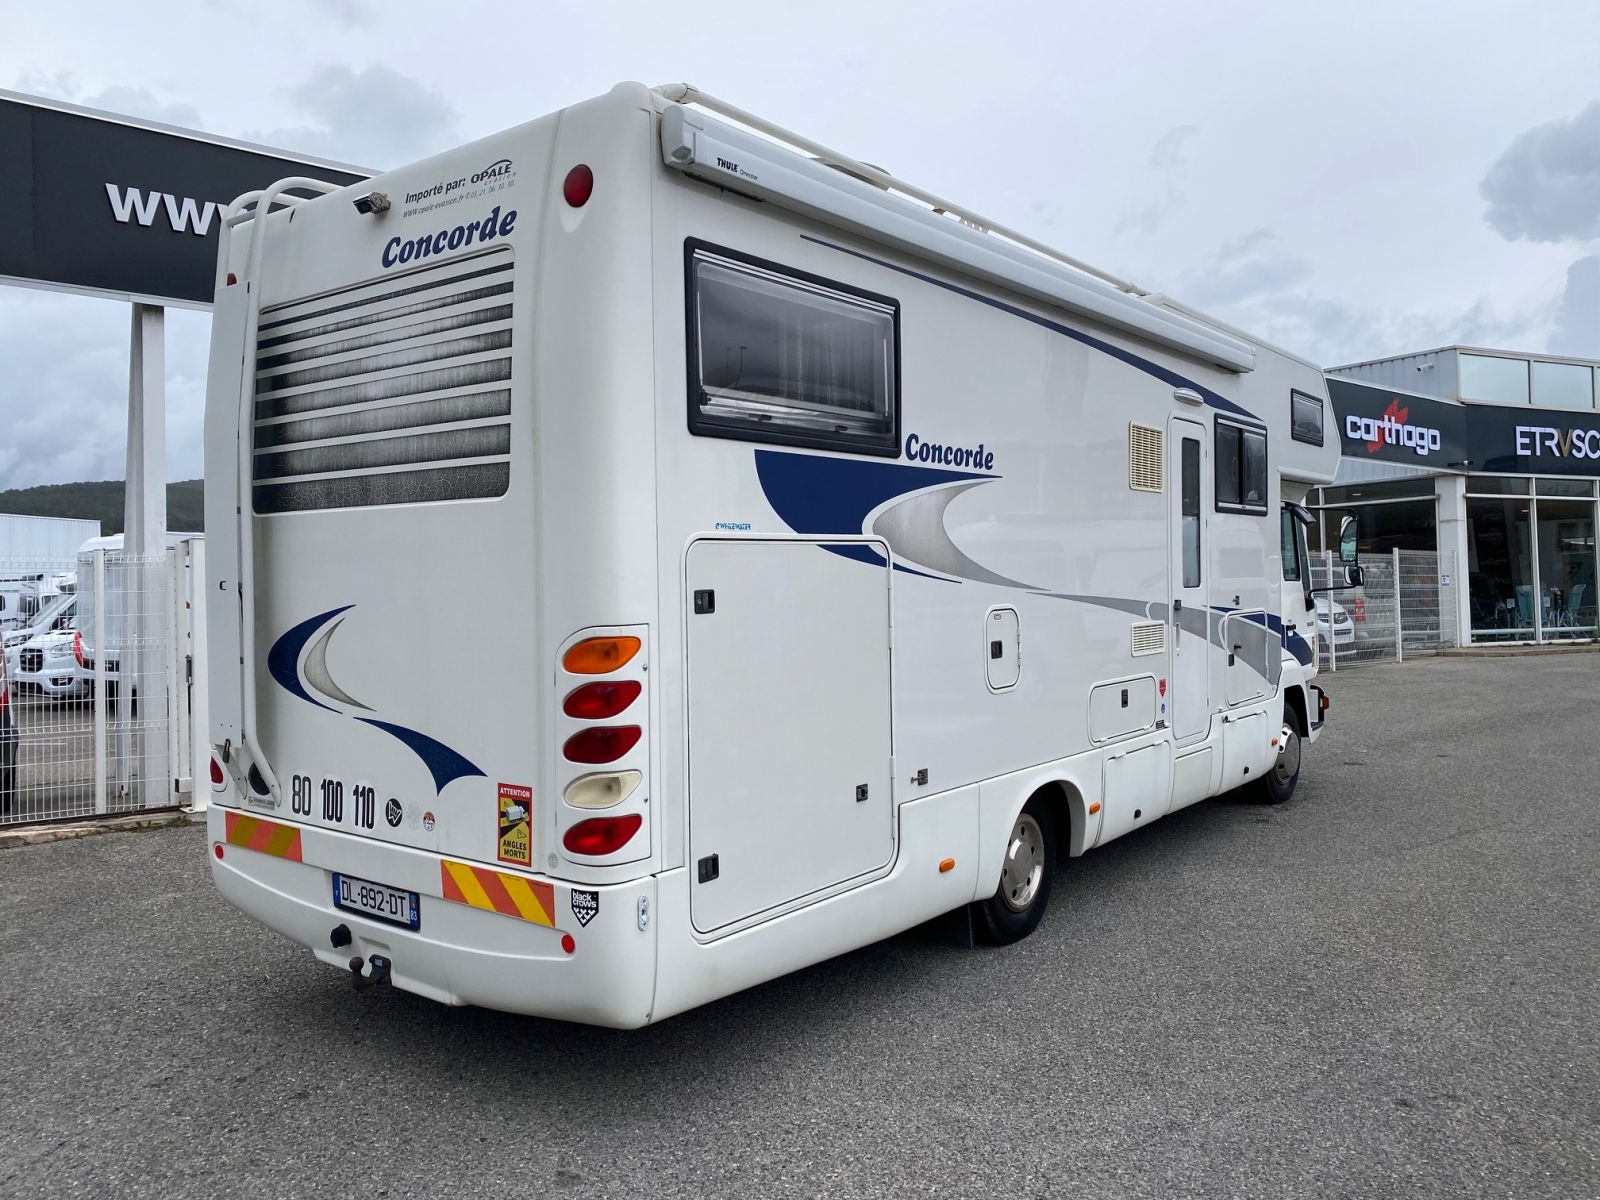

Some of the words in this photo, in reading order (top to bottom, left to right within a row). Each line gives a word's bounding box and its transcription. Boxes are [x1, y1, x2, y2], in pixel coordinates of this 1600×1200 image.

[716, 157, 738, 173] THULE
[405, 182, 443, 204] Importé
[445, 178, 466, 195] par:
[470, 163, 511, 184] OPALE
[382, 205, 517, 268] Concorde
[905, 433, 994, 470] Concorde
[1346, 414, 1441, 456] carthago
[1515, 425, 1600, 459] ETRVSC
[292, 774, 312, 816] 80
[320, 779, 343, 823] 100
[353, 785, 375, 829] 110
[500, 787, 530, 798] ATTENTION
[502, 839, 527, 851] ANGLES
[503, 848, 526, 860] MORTS
[341, 880, 406, 917] DL-892-DT
[572, 890, 592, 902] black
[572, 898, 597, 908] crows
